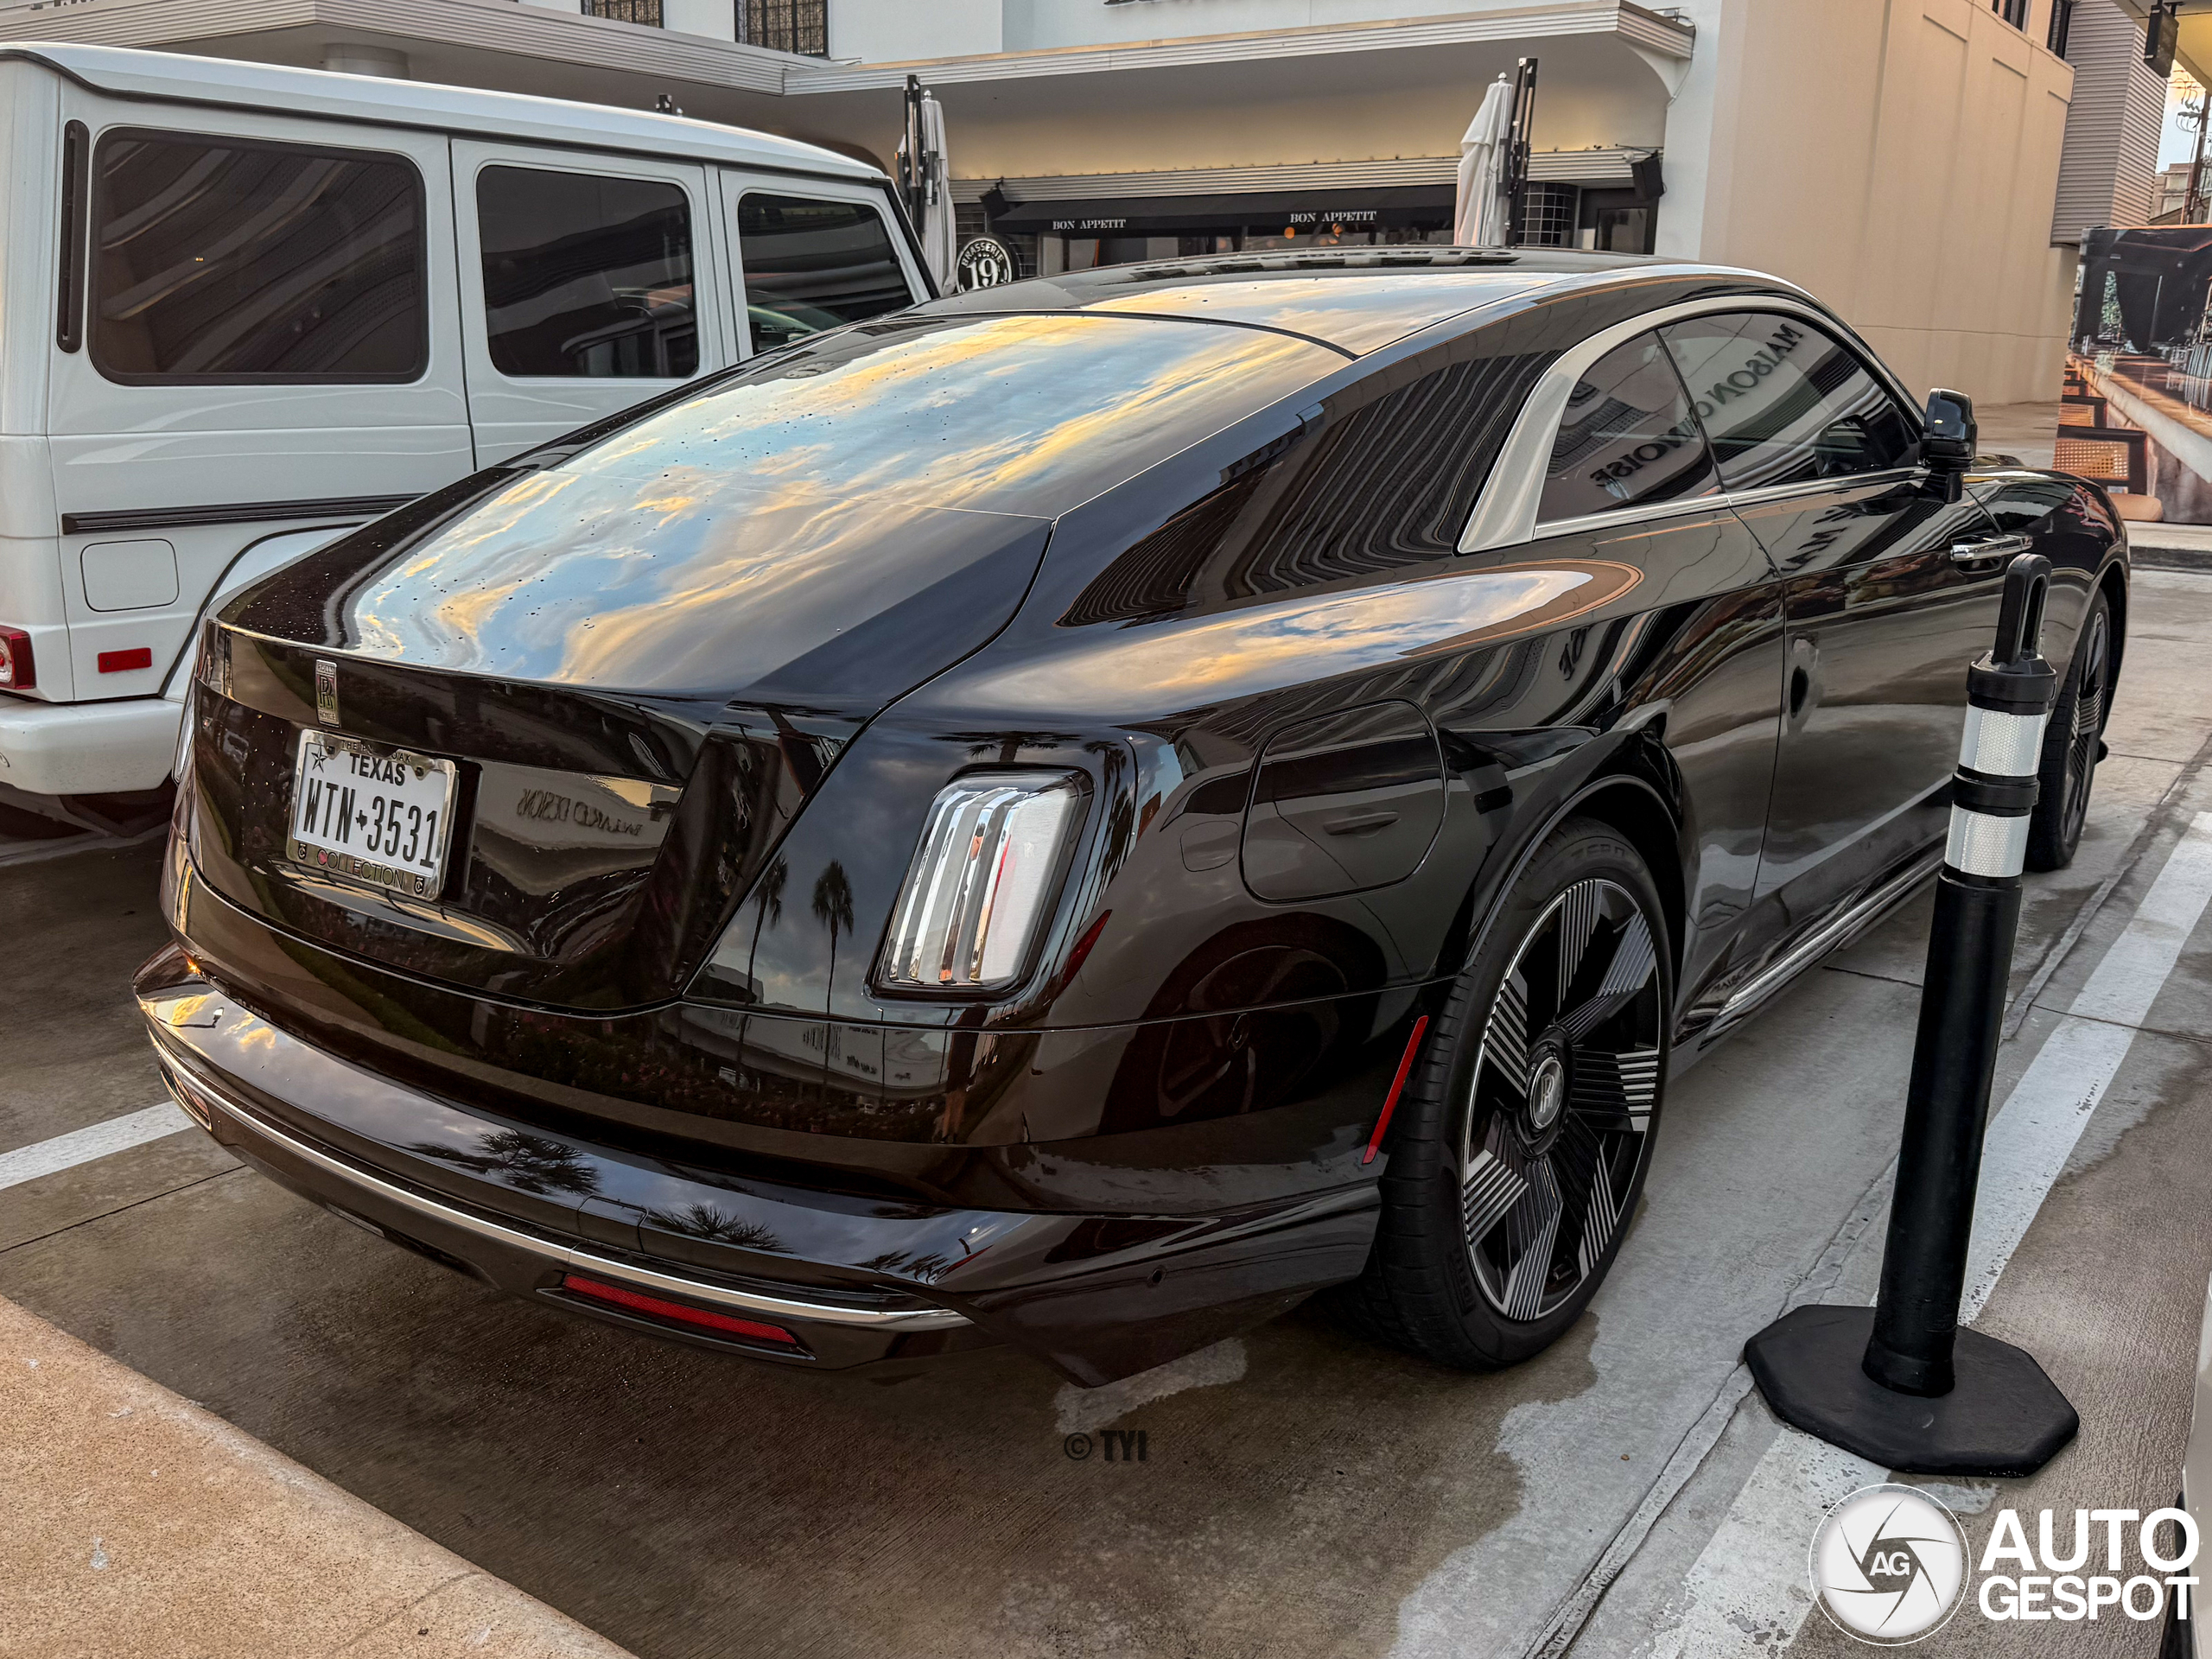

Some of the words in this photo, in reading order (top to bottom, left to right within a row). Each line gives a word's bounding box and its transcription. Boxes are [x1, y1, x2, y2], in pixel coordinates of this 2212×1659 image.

[1052, 220, 1075, 230] BON
[1080, 219, 1127, 229] APPETIT
[1290, 213, 1316, 223] BON
[1322, 211, 1376, 221] APPETIT
[961, 243, 1004, 267] BRASSERIE
[966, 258, 999, 290] 19
[349, 753, 406, 786] TEXAS
[303, 778, 356, 843] WTN
[366, 796, 437, 868] 3531
[316, 849, 404, 890] COLLECTION
